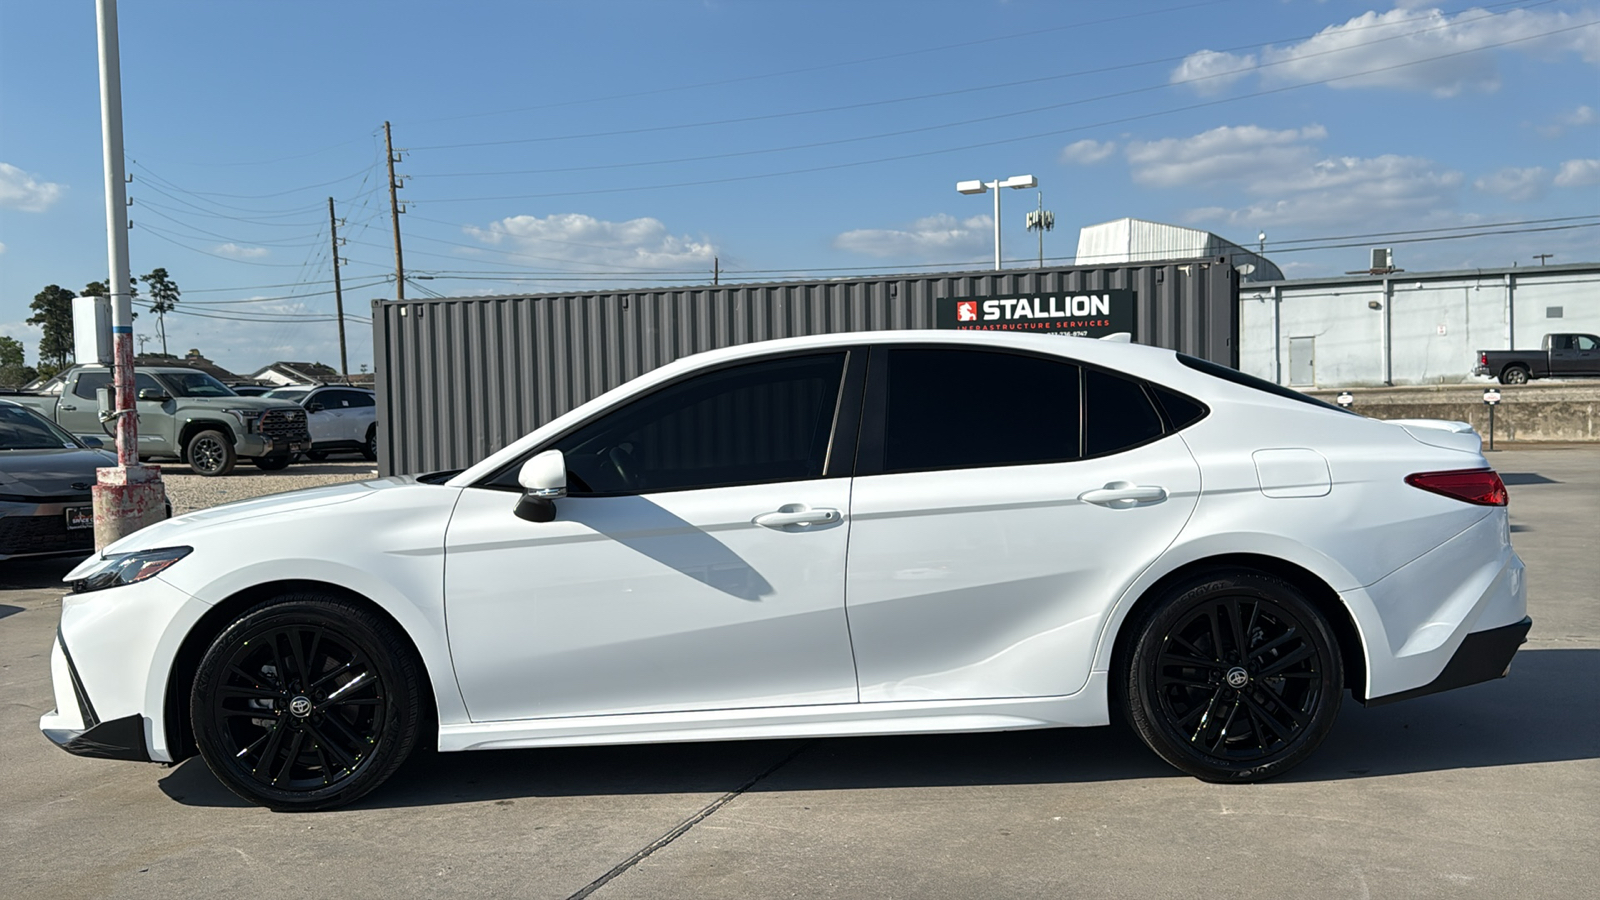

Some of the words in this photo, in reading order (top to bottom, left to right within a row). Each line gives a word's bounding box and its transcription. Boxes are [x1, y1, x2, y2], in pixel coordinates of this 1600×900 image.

[983, 294, 1110, 321] STALLION
[957, 322, 1050, 331] INFRASTRUCTURE
[1056, 320, 1110, 329] SERVICES
